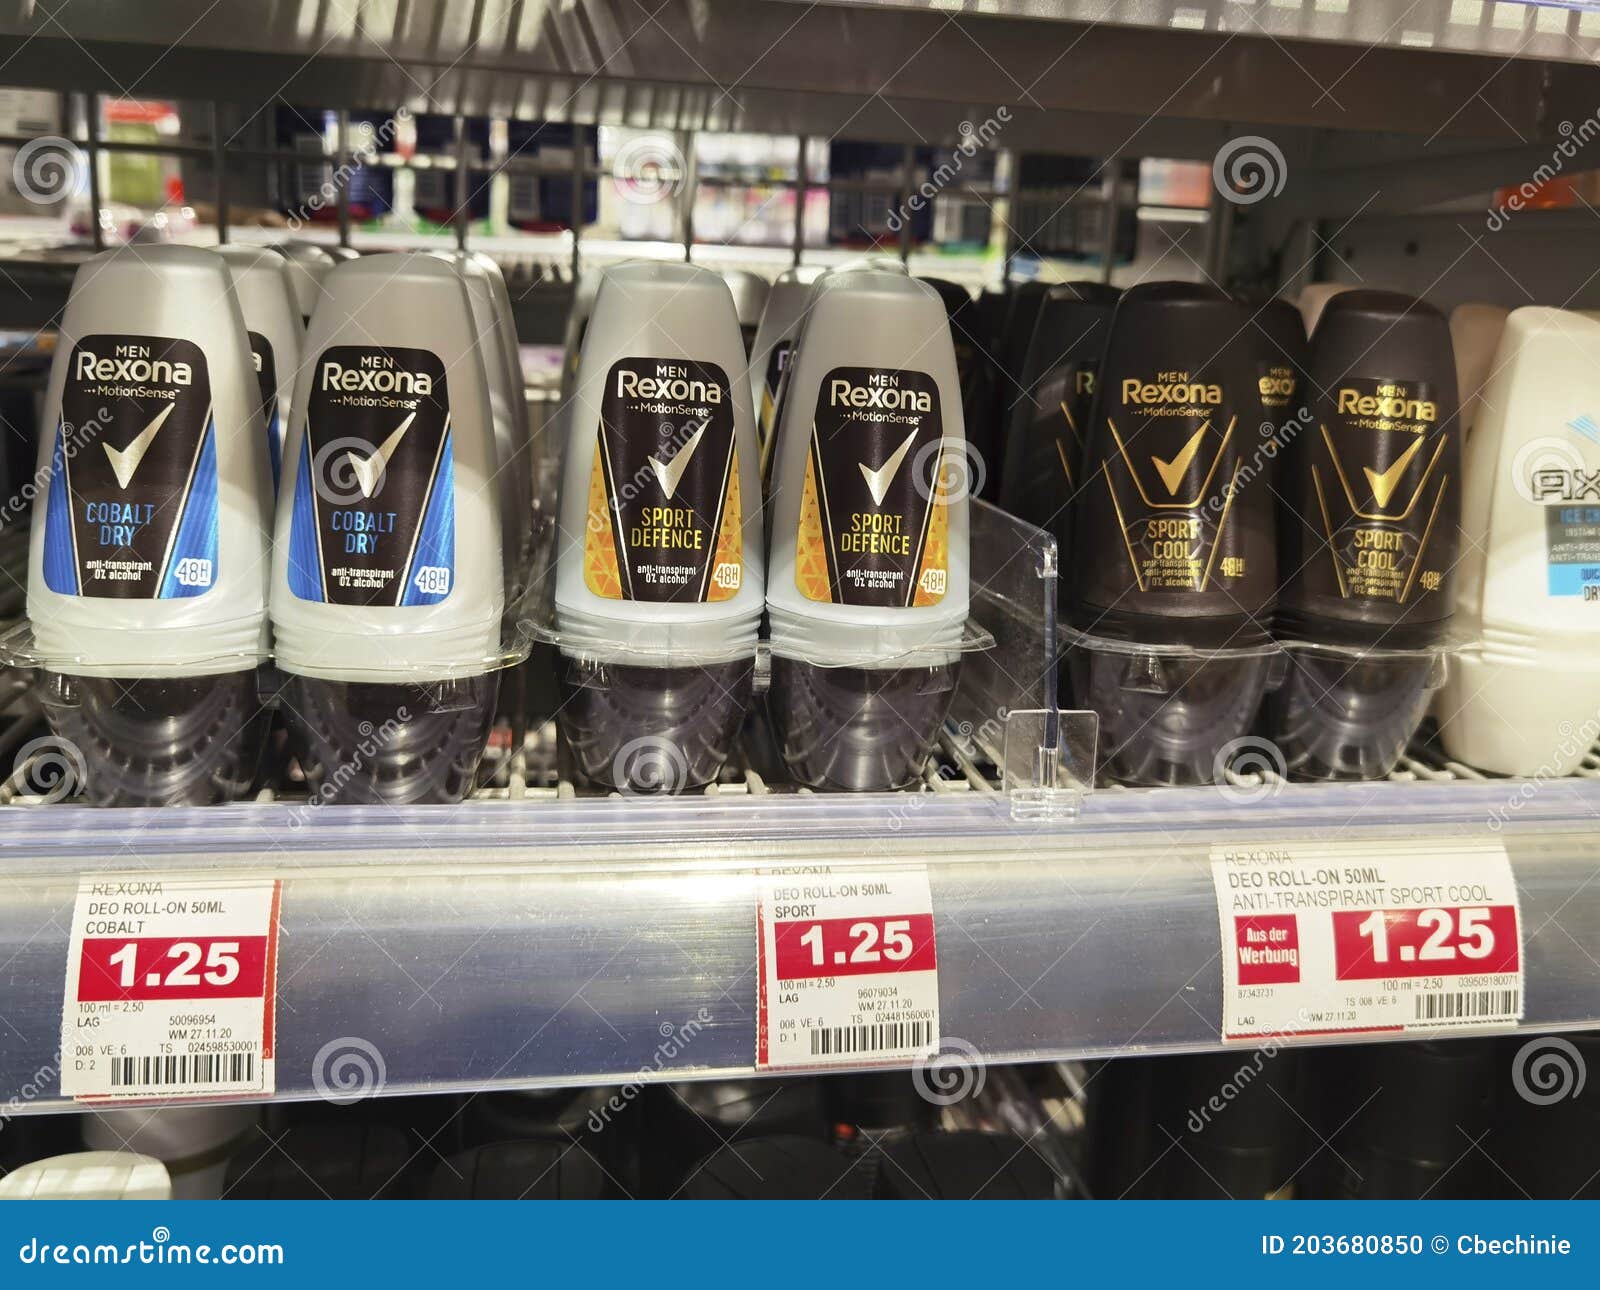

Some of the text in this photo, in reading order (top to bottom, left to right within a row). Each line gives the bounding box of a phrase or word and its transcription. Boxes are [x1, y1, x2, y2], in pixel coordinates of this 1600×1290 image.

[116, 346, 150, 358] MEN
[76, 352, 192, 386] Rexona
[361, 356, 393, 369] MEN
[656, 365, 687, 378] MEN
[322, 362, 432, 396] Rexona
[869, 374, 899, 387] MEN
[1157, 371, 1189, 383] MEN
[617, 370, 721, 404] Rexona
[830, 379, 931, 412] Rexona
[1121, 378, 1224, 406] Rexona
[1338, 388, 1439, 422] Rexona
[1531, 469, 1600, 501] AX
[86, 503, 154, 524] COBALT
[331, 511, 397, 533] COBALT
[641, 507, 694, 528] SPORT
[851, 513, 902, 534] SPORT
[1147, 519, 1200, 540] SPORT
[100, 525, 136, 546] DRY
[345, 533, 379, 554] DRY
[631, 528, 702, 549] DEFENCE
[841, 533, 910, 555] DEFENCE
[1354, 529, 1403, 551] SPORT
[1153, 541, 1194, 560] COOL
[1358, 550, 1397, 571] COOL
[109, 570, 142, 581] alcohol
[353, 577, 385, 589] alcohol
[659, 573, 688, 585] alcohol
[867, 578, 896, 589] alcohol
[1228, 867, 1386, 888] DEO ROLL-ON 50ML
[774, 883, 892, 901] DEO ROLL-ON 50ML
[1232, 884, 1494, 910] ANTI-TRANSPIRANT SPORT COOL
[88, 900, 226, 915] DEO ROLL-ON 50ML
[775, 904, 817, 918] SPORT
[85, 920, 145, 934] COBALT
[1246, 927, 1288, 942] Aus der
[1358, 907, 1495, 963] 1.25
[800, 920, 913, 966] 1.25
[109, 942, 240, 987] 1.25
[1238, 946, 1299, 968] Werbung
[779, 981, 795, 991] 100
[796, 980, 807, 990] ml
[817, 978, 836, 989] 2.50
[1383, 981, 1398, 992] 100
[1423, 978, 1443, 989] 2.50
[779, 987, 898, 1004] LAG 96079034
[79, 1003, 96, 1013] 100
[99, 1002, 111, 1013] ml
[123, 1002, 144, 1013] 2.50
[858, 1001, 875, 1012] WM
[77, 1015, 216, 1028] LAG 50096954
[779, 1019, 796, 1030] 008
[851, 1014, 863, 1025] TS
[1237, 1016, 1256, 1026] LAG
[169, 1028, 232, 1040] WM 27.11.20
[75, 1046, 93, 1056] 008
[160, 1044, 173, 1054] TS
[188, 1041, 258, 1053] 024598530001
